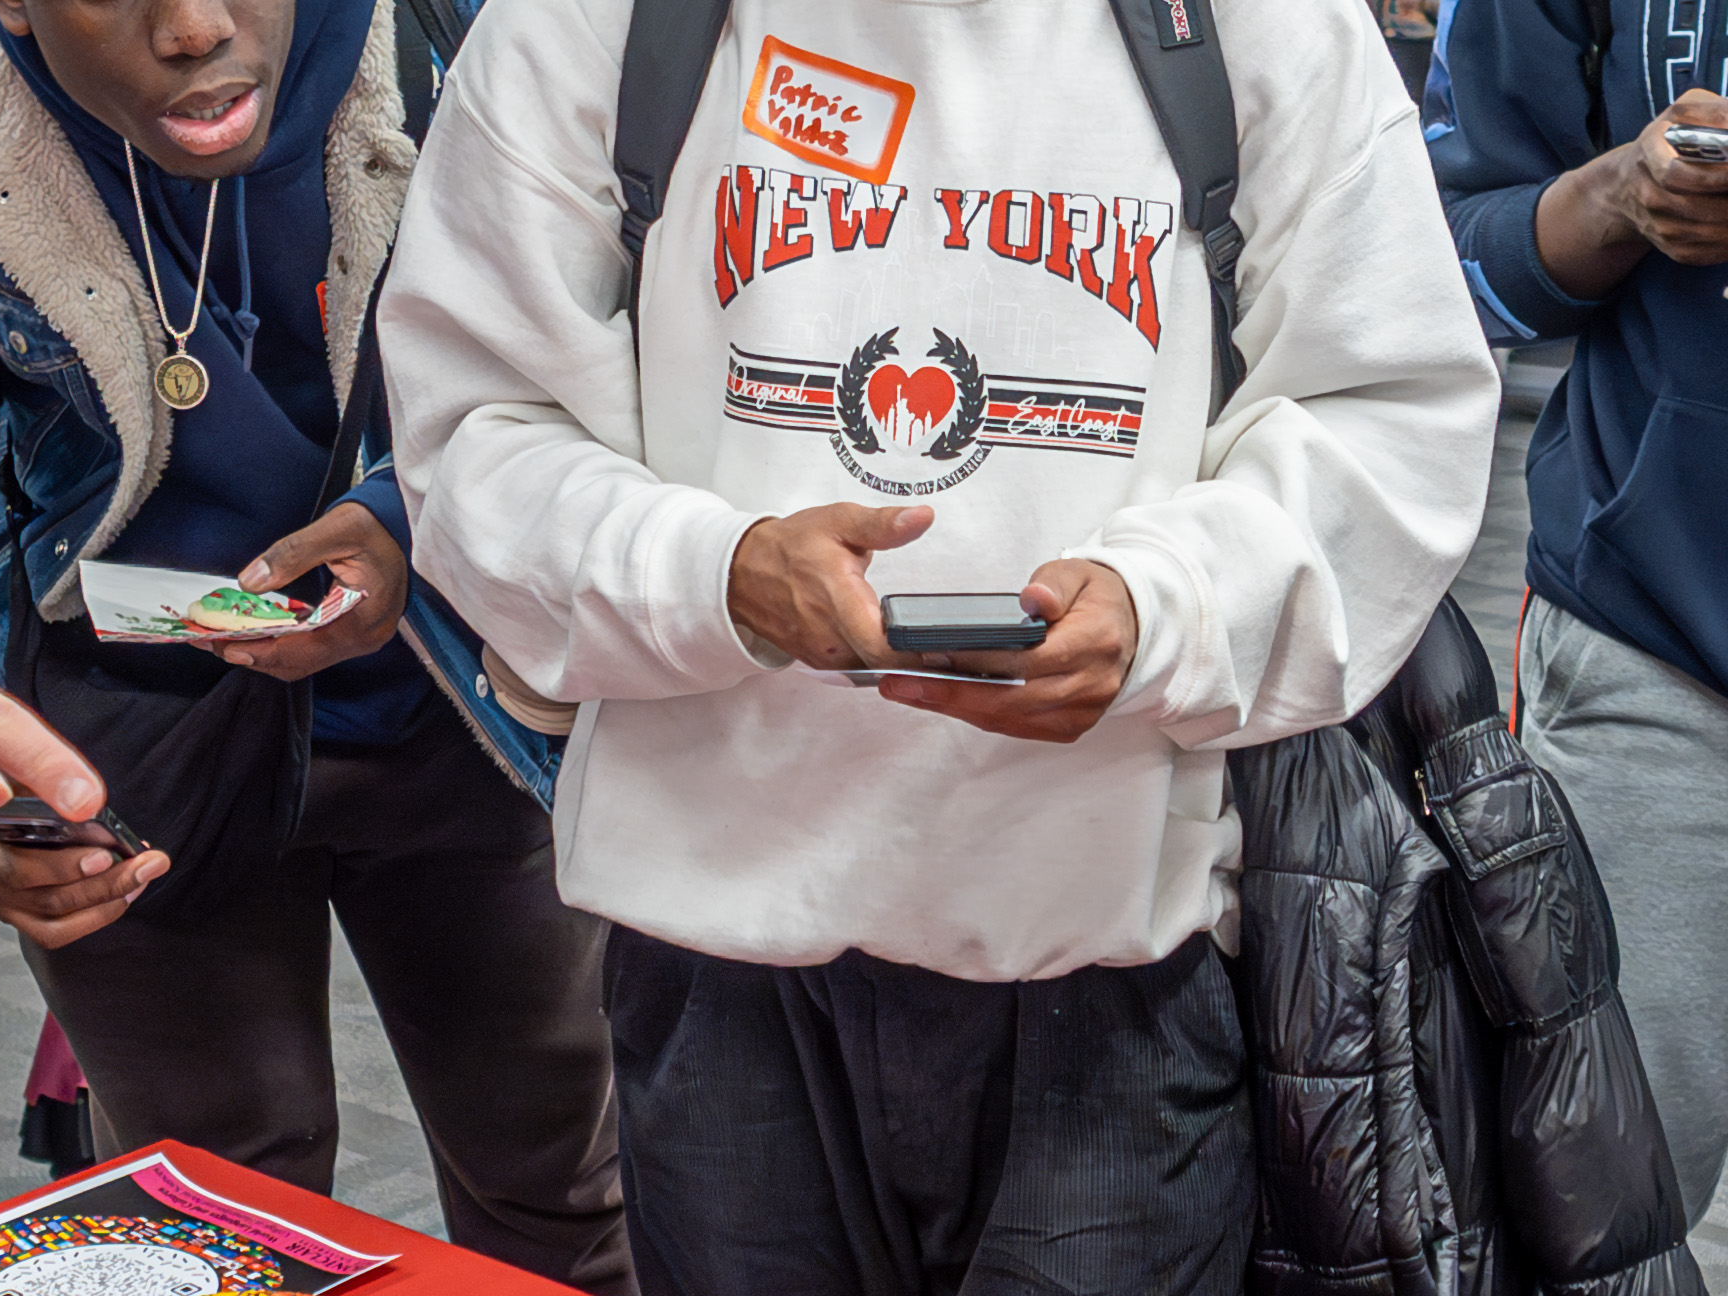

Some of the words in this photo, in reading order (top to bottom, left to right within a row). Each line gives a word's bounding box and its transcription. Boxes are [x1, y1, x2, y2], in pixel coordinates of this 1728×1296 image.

[713, 162, 907, 310] NEW
[933, 186, 1174, 354] YORK
[730, 365, 810, 410] Original
[1007, 395, 1064, 437] East
[1061, 399, 1130, 443] Coast
[829, 432, 863, 478] UNITED
[860, 471, 913, 496] STATES
[913, 480, 934, 495] OF
[936, 444, 994, 492] AMERICA
